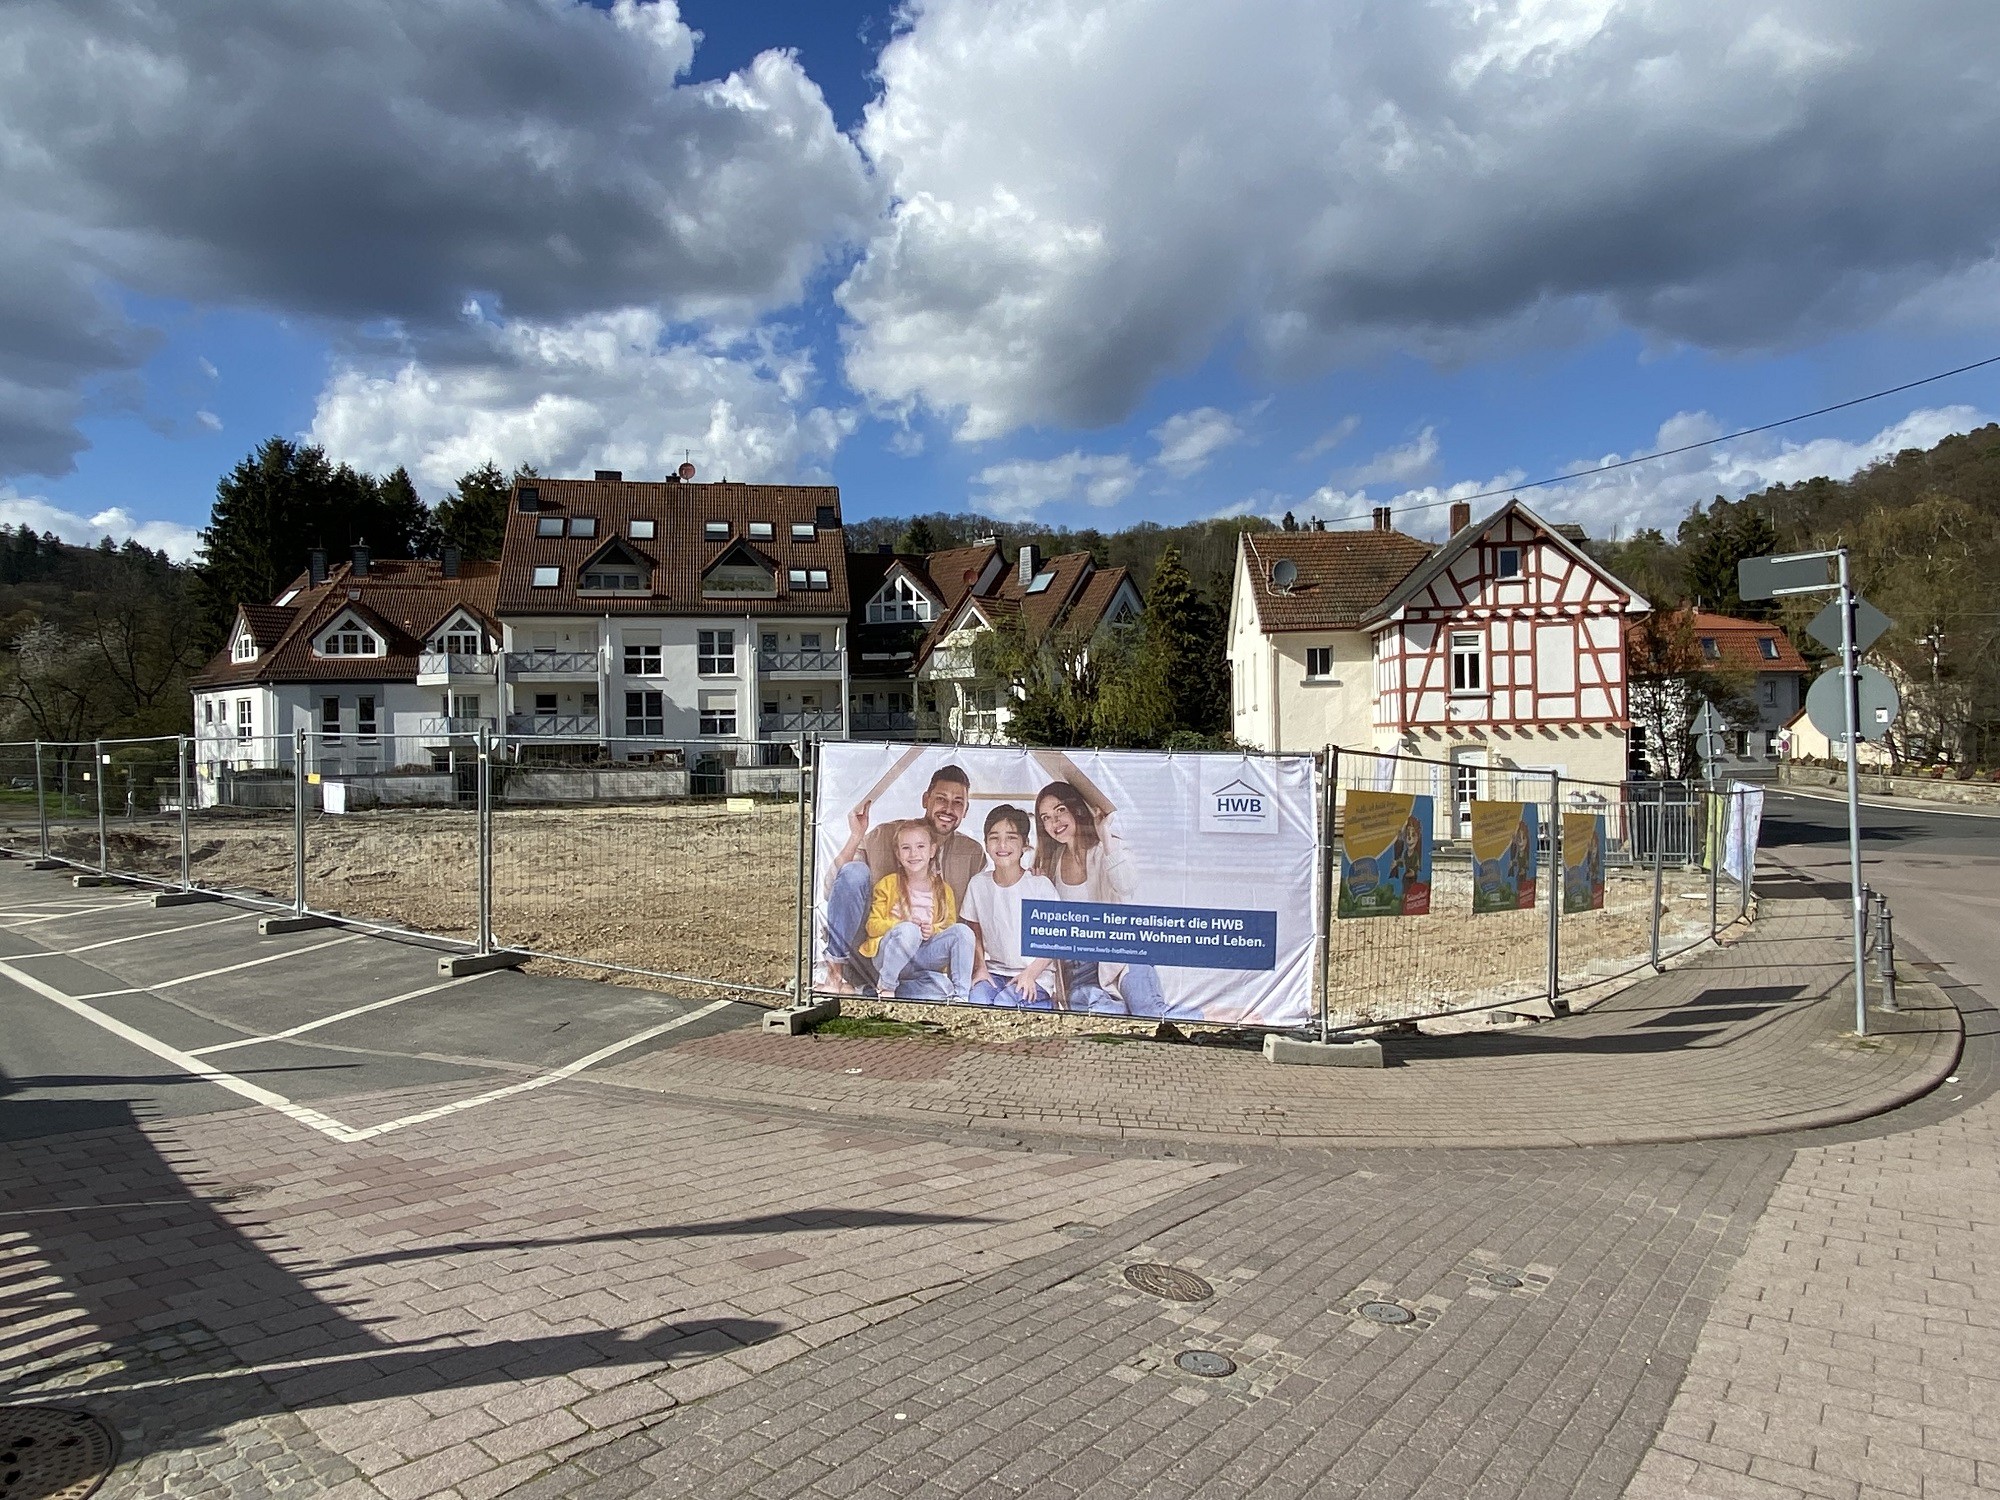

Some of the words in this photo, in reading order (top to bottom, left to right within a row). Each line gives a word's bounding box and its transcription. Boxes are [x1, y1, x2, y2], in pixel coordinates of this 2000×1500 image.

[1217, 798, 1262, 812] HWB
[1030, 909, 1090, 923] Anpacken
[1103, 912, 1128, 925] hier
[1130, 915, 1185, 928] realisiert
[1188, 917, 1208, 929] die
[1211, 918, 1244, 930] HWB
[1030, 926, 1067, 937] neuen
[1070, 926, 1106, 939] Raum
[1109, 931, 1136, 941] zum
[1139, 930, 1191, 944] Wohnen
[1195, 934, 1220, 945] und
[1223, 935, 1266, 948] Leben.
